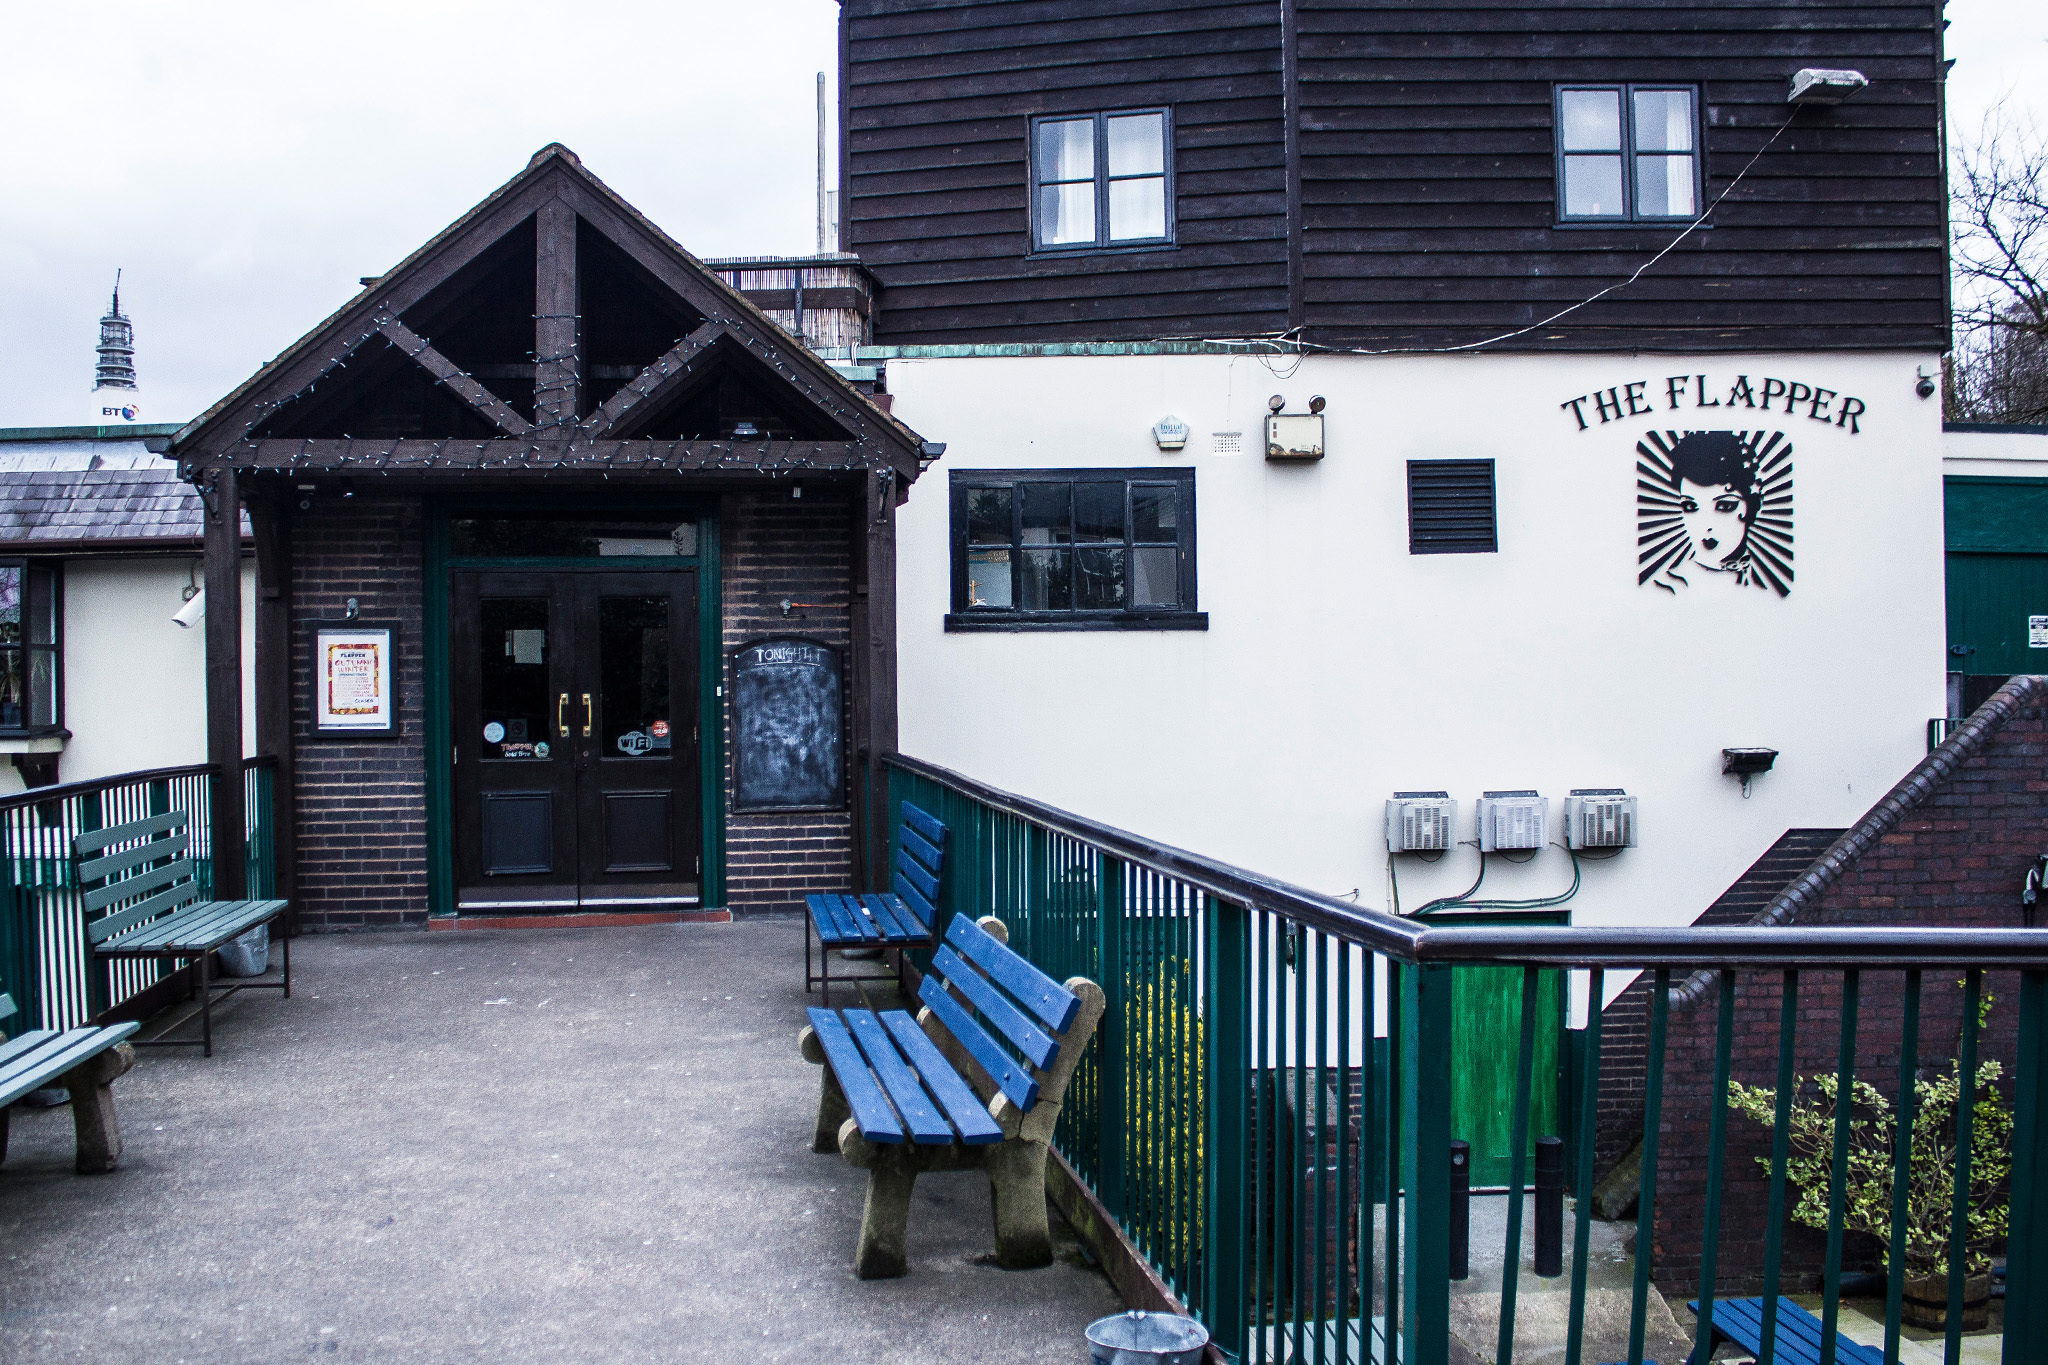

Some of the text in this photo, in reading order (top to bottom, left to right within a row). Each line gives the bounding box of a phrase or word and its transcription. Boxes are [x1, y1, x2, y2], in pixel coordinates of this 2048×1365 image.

[103, 407, 121, 416] BT
[1561, 375, 1866, 435] THE FLAPPER
